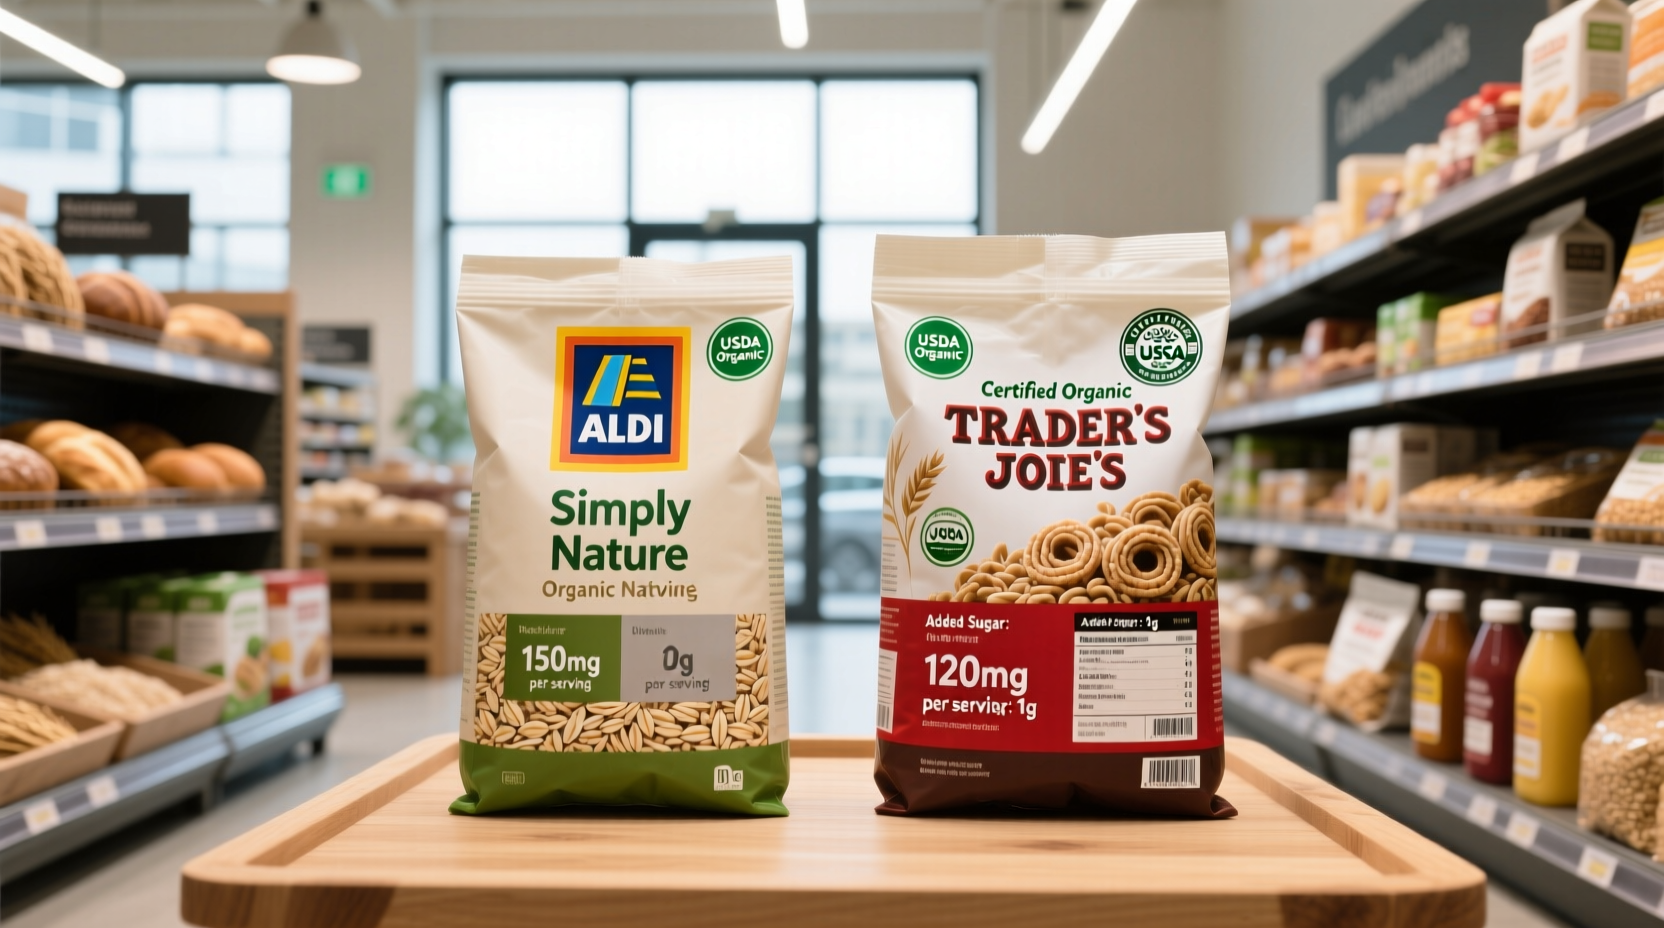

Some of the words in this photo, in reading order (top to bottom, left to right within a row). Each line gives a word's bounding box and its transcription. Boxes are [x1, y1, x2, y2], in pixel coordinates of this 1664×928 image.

[720, 335, 761, 350] USDA
[918, 333, 960, 349] USDA
[716, 349, 765, 364] Organic
[914, 347, 963, 361] Organic
[981, 380, 1057, 399] Certified
[1061, 382, 1132, 404] Organic
[578, 413, 663, 443] ALDI
[944, 403, 1172, 447] TRADER'S
[985, 450, 1127, 491] JOIE'S
[550, 489, 691, 536] Simply
[551, 535, 688, 571] Nature
[542, 580, 615, 603] Organic
[925, 614, 965, 628] Added
[967, 615, 1009, 631] Sugar:
[522, 645, 600, 677] 150mg
[662, 645, 694, 676] 0g
[529, 679, 547, 692] per
[550, 677, 591, 692] serving
[924, 654, 1029, 696] 120mg
[922, 697, 949, 715] per
[1017, 697, 1038, 721] 1g
